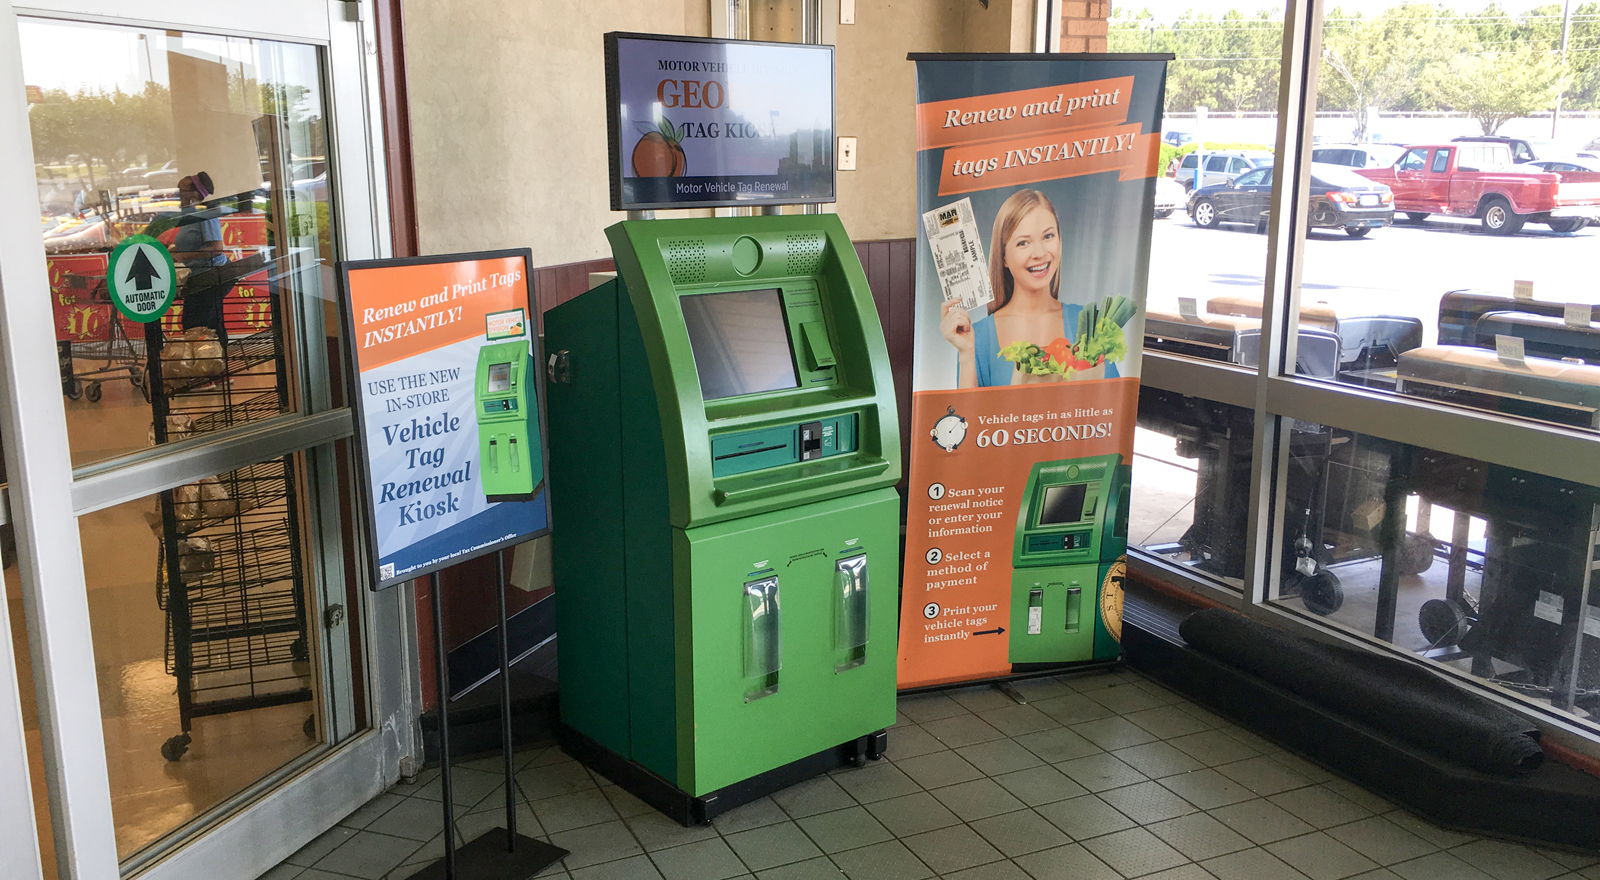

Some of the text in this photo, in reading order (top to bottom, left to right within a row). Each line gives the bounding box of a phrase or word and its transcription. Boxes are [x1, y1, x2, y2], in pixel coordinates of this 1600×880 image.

[658, 60, 700, 72] MOTOR
[943, 88, 1121, 129] Renew and print
[683, 122, 720, 139] TAG
[952, 132, 1136, 178] tags INSTANTLY!
[676, 181, 789, 194] Motor Vehicle Tag Renewal
[939, 208, 957, 221] MAR
[125, 290, 165, 304] AUTOMATIC
[238, 286, 254, 298] for
[363, 270, 521, 326] Renew and Print Tags
[137, 302, 156, 312] DOOR
[363, 306, 463, 349] INSTANTLY!
[368, 368, 461, 396] USE THE NEW
[386, 389, 450, 413] IN-STORE
[978, 407, 1114, 425] Vehicle tags in as little as
[383, 412, 460, 446] Vehicle
[976, 422, 1113, 448] 60 SECONDS!
[405, 447, 445, 470] Tag
[379, 460, 471, 504] Renewal
[948, 489, 975, 499] Scan
[977, 485, 1004, 498] your
[398, 492, 460, 528] Kiosk
[929, 497, 1004, 512] renewal notice
[928, 511, 1003, 525] or enter your
[928, 525, 993, 538] information
[396, 565, 417, 576] Brought
[423, 560, 432, 568] you
[450, 549, 462, 558] local
[470, 537, 504, 552] Commissioner's
[505, 532, 517, 541] Office
[945, 552, 981, 562] Select
[926, 561, 988, 577] method of
[926, 576, 978, 591] payment
[942, 605, 971, 617] Print
[973, 603, 998, 616] your
[924, 616, 988, 631] vehicle tags
[924, 630, 970, 643] instantly
